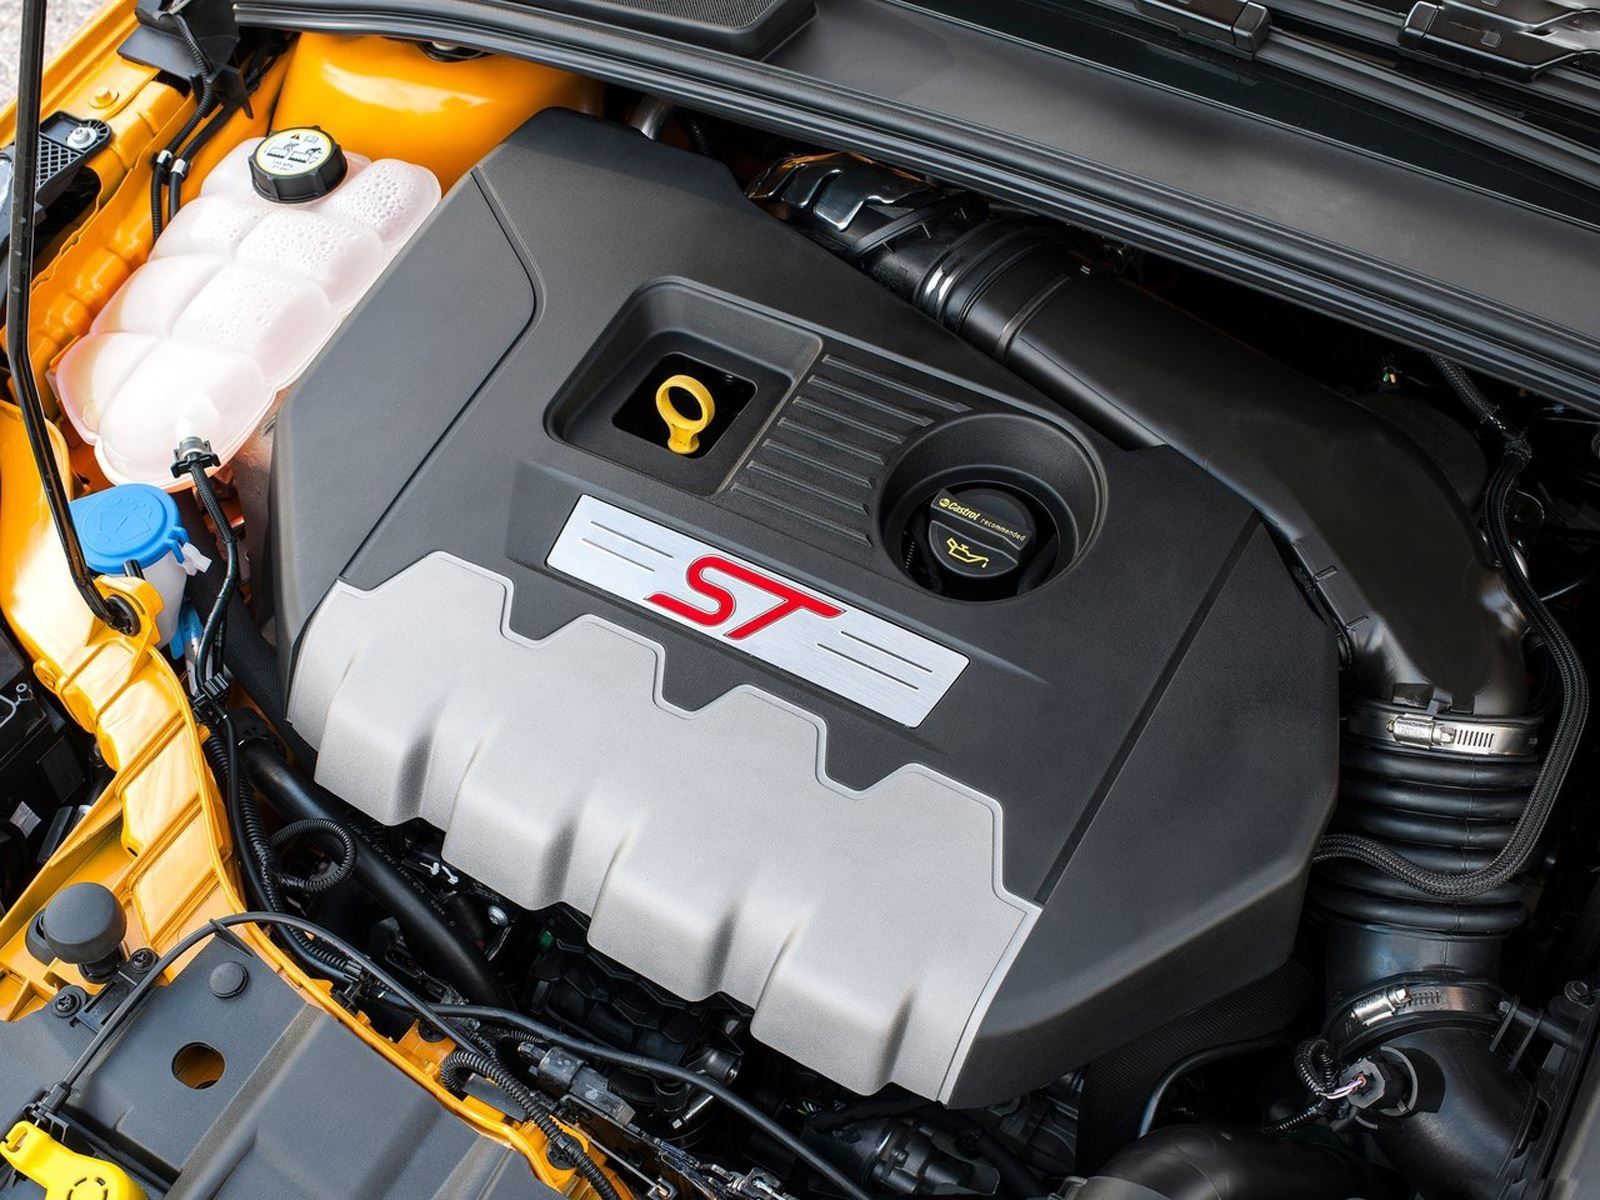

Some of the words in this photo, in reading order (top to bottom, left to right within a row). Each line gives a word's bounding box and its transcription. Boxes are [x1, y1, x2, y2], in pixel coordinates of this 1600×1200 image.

[948, 502, 981, 520] Castrol
[981, 518, 1026, 541] recommended
[644, 554, 846, 640] ST
